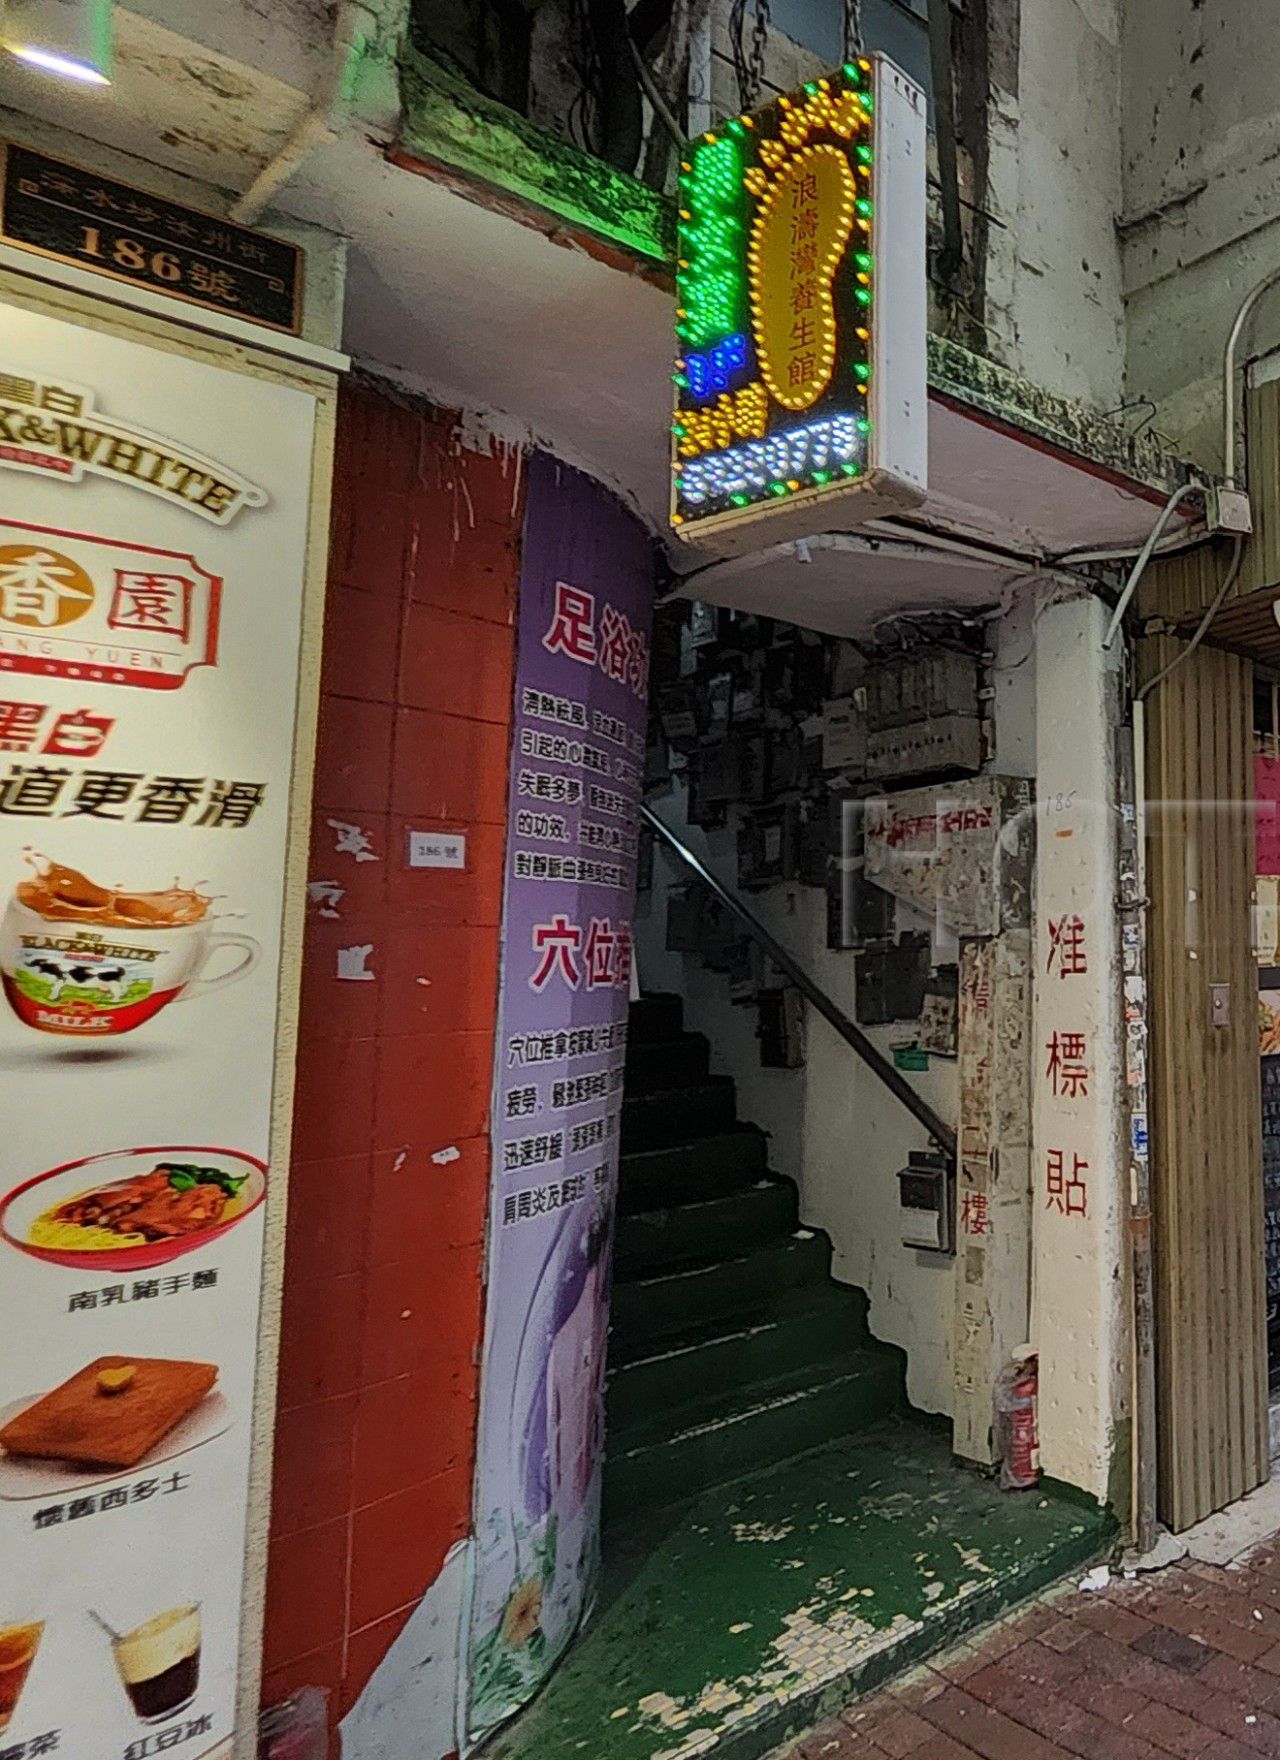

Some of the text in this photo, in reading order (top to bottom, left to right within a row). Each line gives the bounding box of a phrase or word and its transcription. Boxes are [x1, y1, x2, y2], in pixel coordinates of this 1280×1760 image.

[76, 226, 241, 303] 186號
[0, 551, 196, 645] 香園
[85, 646, 164, 670] YUEN
[35, 1010, 114, 1028] MILK
[1045, 912, 1090, 1219] 准標貼
